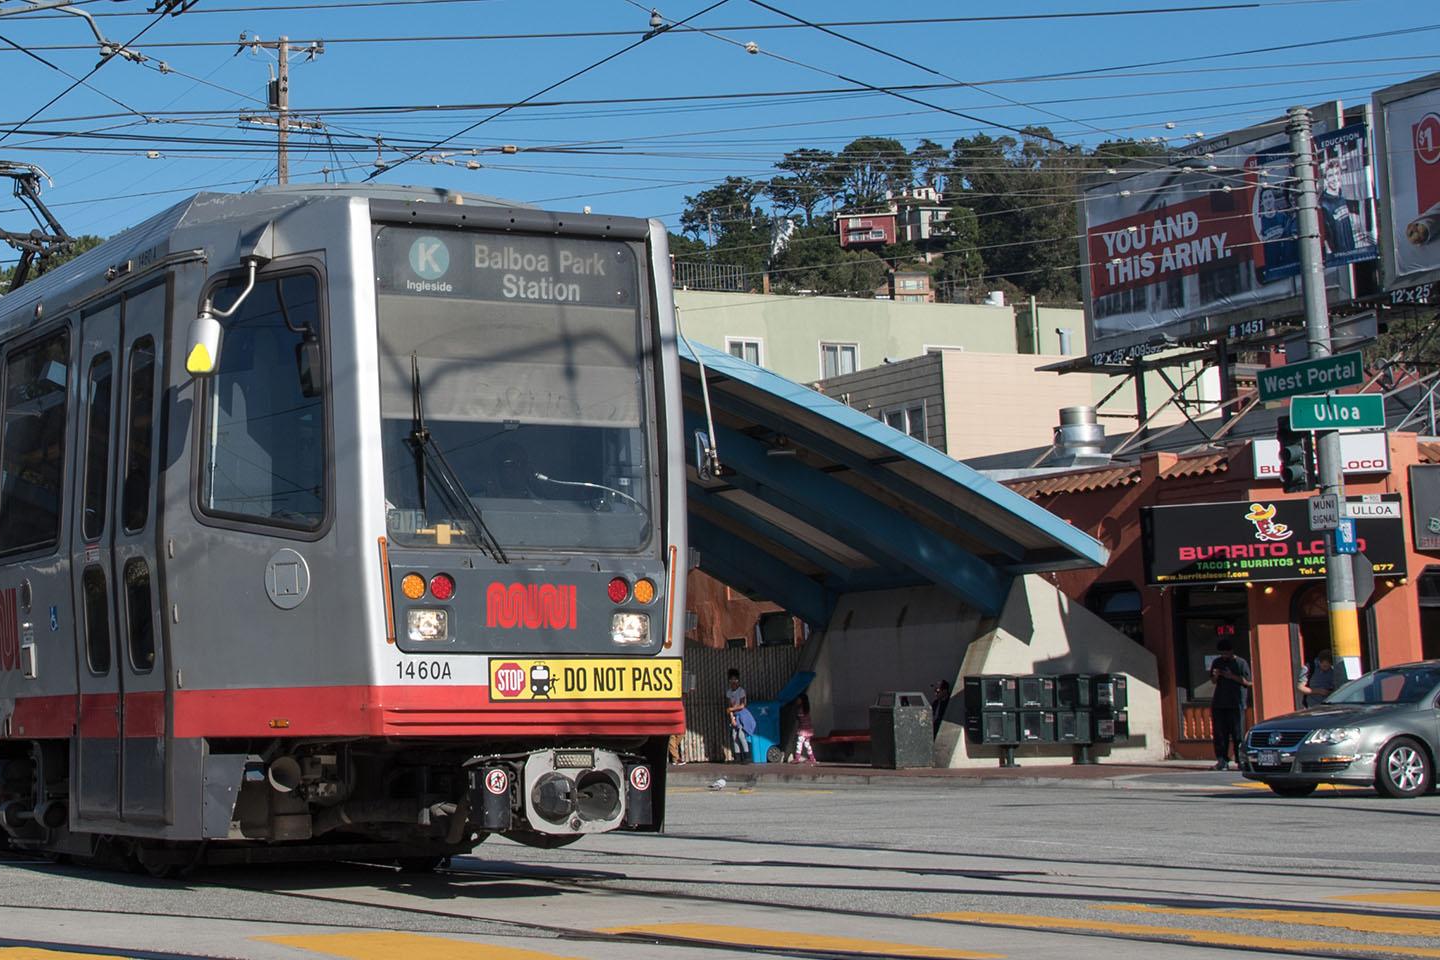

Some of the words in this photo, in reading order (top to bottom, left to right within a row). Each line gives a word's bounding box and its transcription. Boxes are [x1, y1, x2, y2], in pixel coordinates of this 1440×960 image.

[1320, 132, 1360, 148] EDUCATION
[1103, 223, 1146, 257] YOU
[1151, 211, 1198, 246] AND
[418, 243, 441, 272] K
[474, 244, 549, 271] Balboa
[560, 250, 606, 276] Park
[1106, 251, 1155, 286] THIS
[1160, 231, 1232, 273] ARMY.
[406, 280, 453, 292] Ingleside
[502, 274, 581, 301] Station
[1240, 319, 1264, 335] 1451
[1264, 371, 1302, 393] West
[1307, 361, 1355, 385] Portal
[1313, 404, 1360, 421] Ulloa
[1313, 501, 1335, 510] MUNI
[1352, 506, 1393, 515] ULLOA
[1312, 515, 1337, 527] SIGNAL
[1179, 543, 1288, 561] BURRITO
[1297, 538, 1366, 556] LOO
[1197, 561, 1230, 570] TACOS
[1240, 558, 1293, 569] BURRITOS
[1298, 567, 1316, 575] Tel.
[486, 581, 577, 630] MUNI
[396, 661, 452, 680] 1460A
[497, 666, 525, 691] STOP
[564, 668, 587, 692] DO
[593, 667, 626, 692] NOT
[632, 666, 673, 691] PASS
